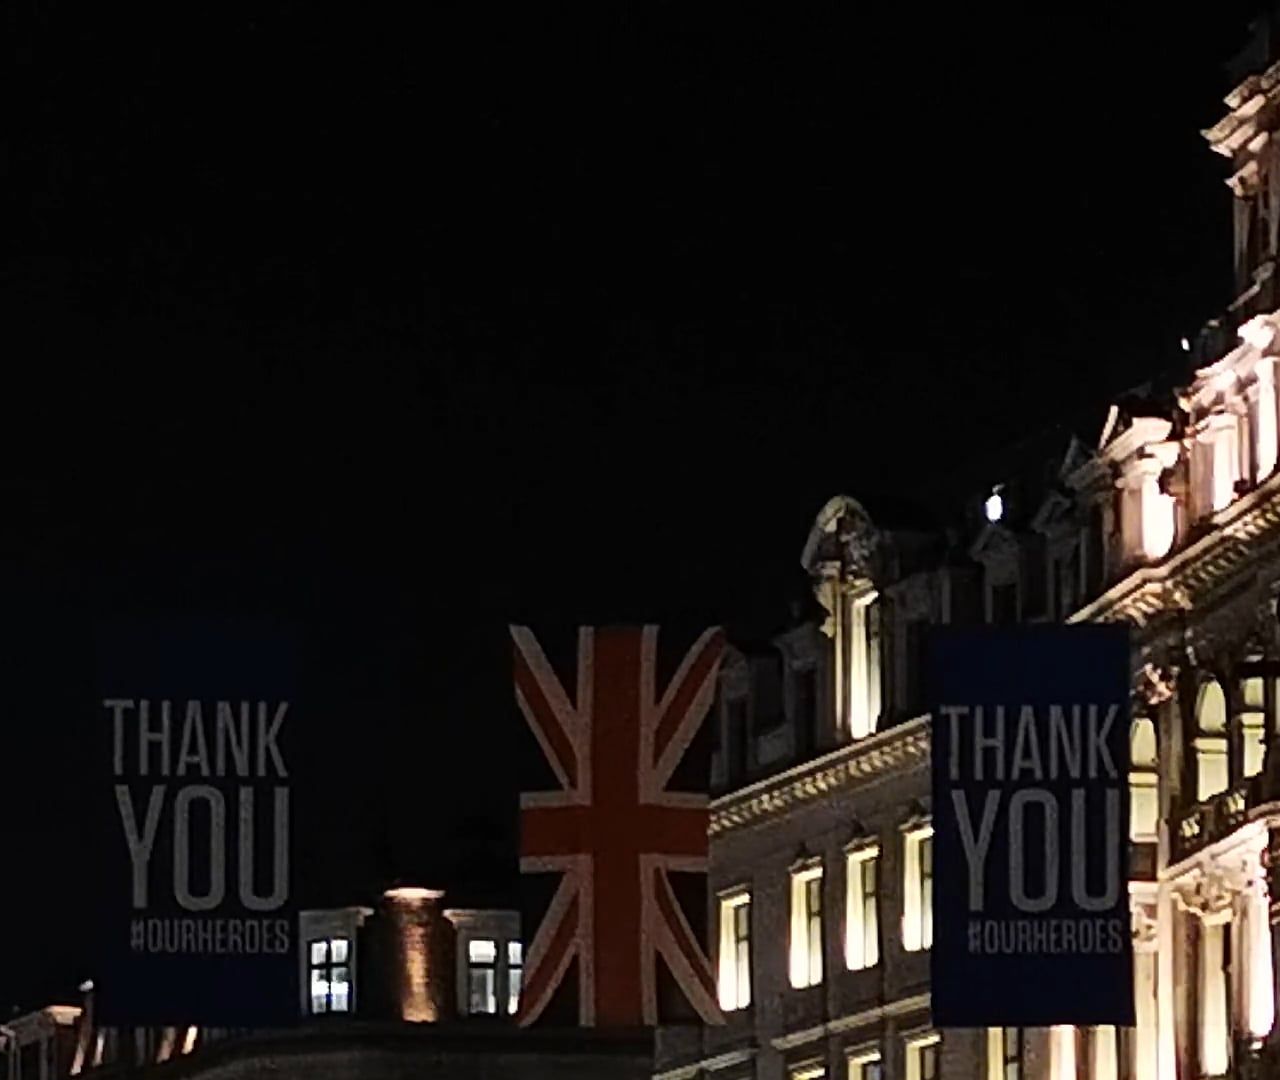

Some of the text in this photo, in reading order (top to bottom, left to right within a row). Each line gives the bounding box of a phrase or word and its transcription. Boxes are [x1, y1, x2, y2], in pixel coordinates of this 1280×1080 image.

[102, 698, 290, 778] THANK
[939, 703, 1120, 782] THANK
[114, 783, 291, 912] YOU
[951, 787, 1120, 913] YOU
[129, 918, 291, 954] #OURHEROES
[968, 919, 1122, 954] #OURHEROES
